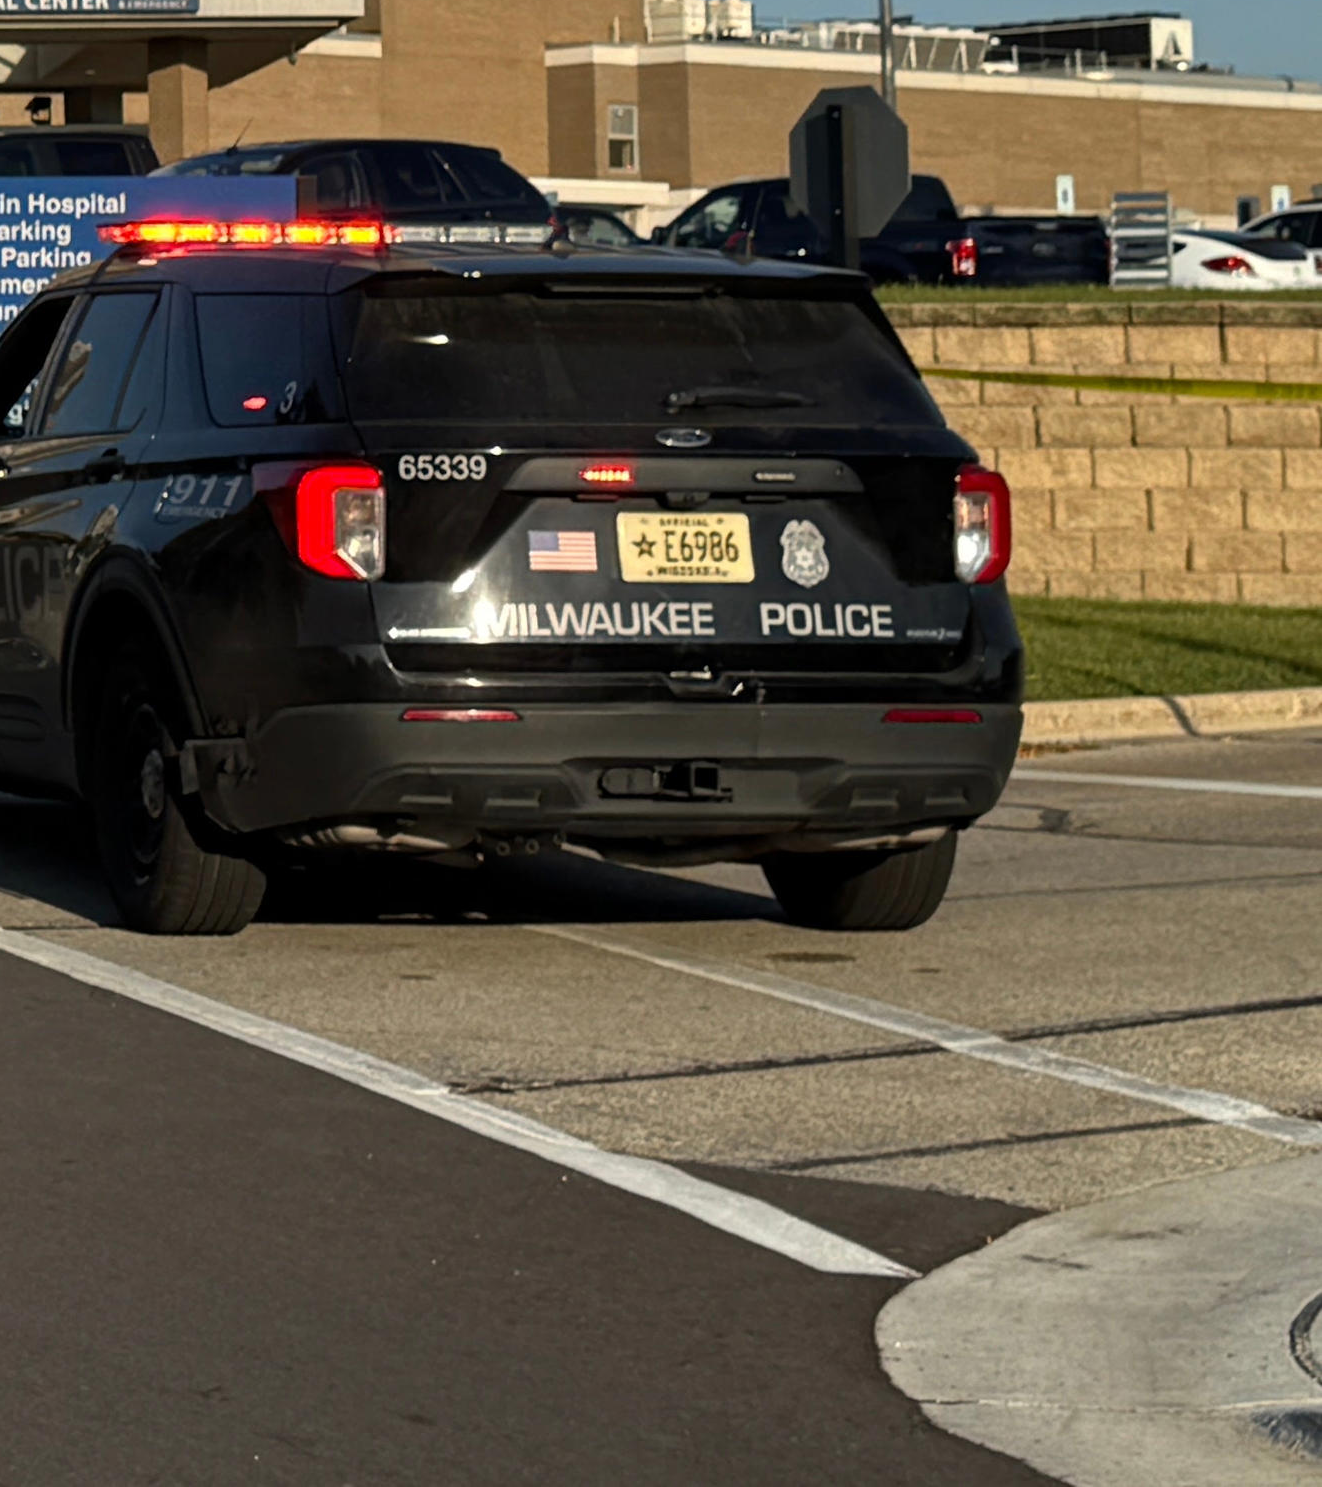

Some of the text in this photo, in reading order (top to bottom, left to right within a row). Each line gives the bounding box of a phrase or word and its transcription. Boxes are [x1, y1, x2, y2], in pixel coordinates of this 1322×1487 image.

[28, 193, 126, 219] Hospital
[398, 454, 487, 481] 65339
[169, 473, 244, 507] 911
[662, 530, 739, 563] E6986
[759, 602, 895, 638] POLICE
